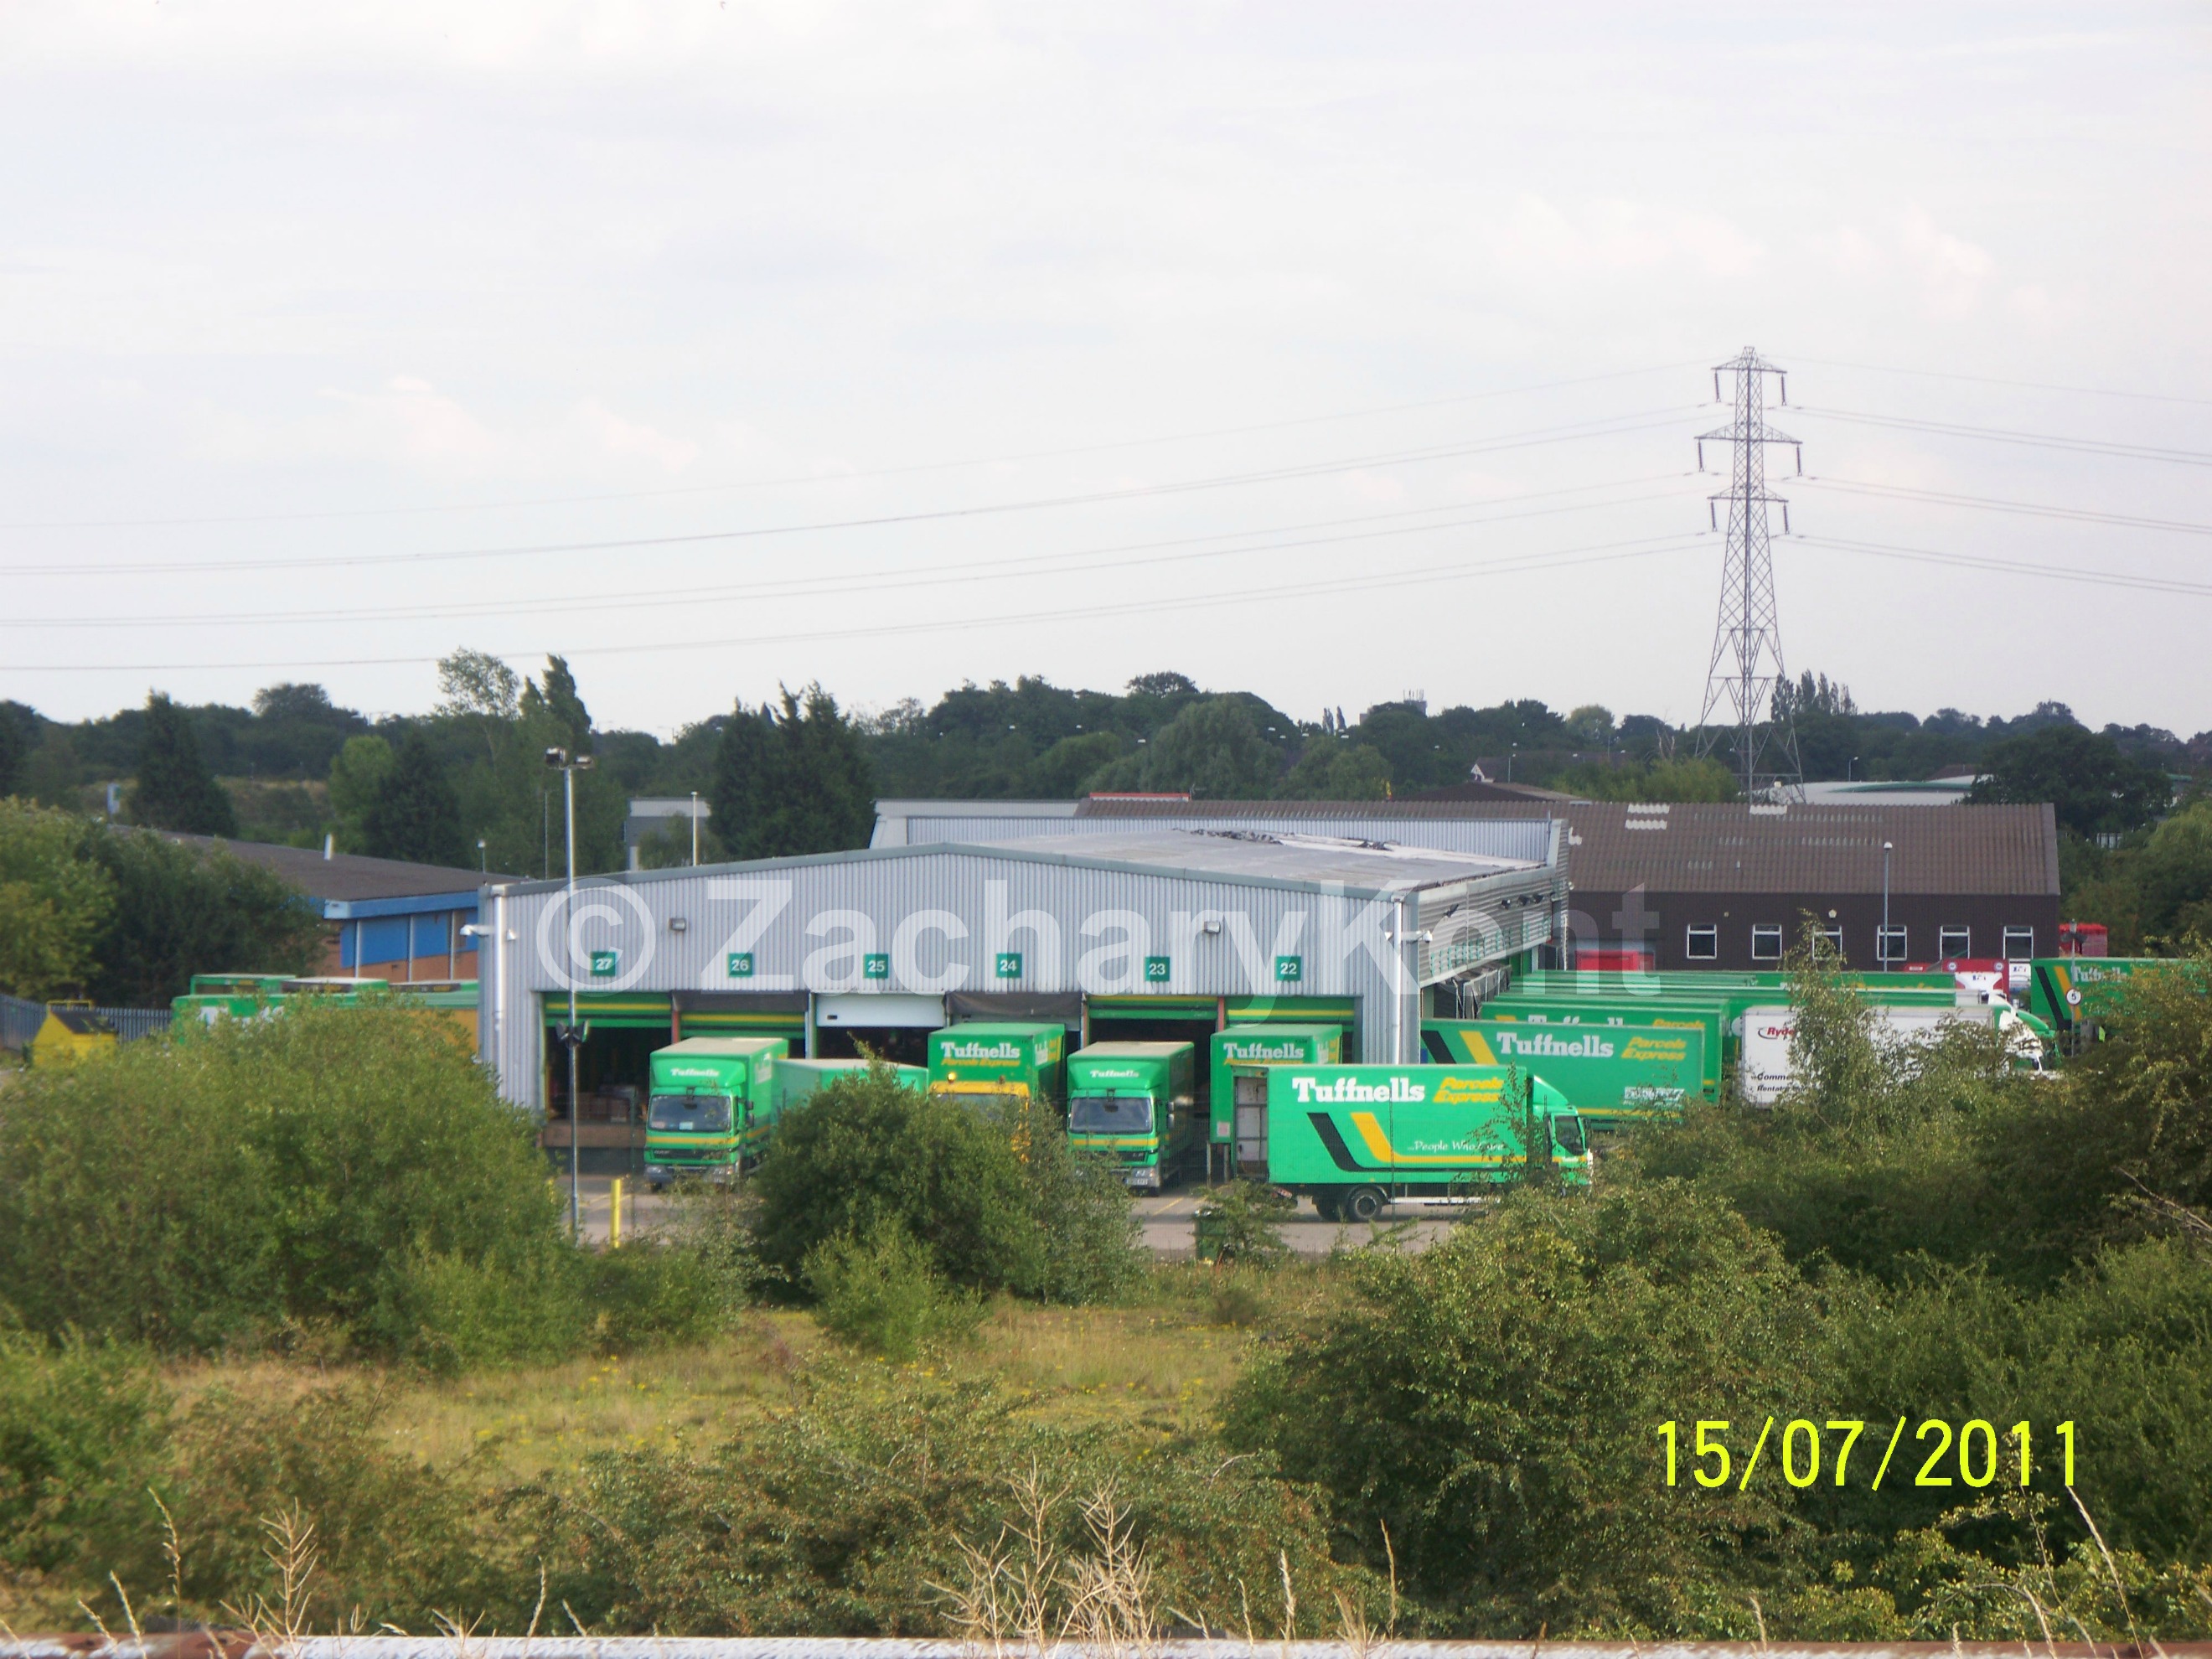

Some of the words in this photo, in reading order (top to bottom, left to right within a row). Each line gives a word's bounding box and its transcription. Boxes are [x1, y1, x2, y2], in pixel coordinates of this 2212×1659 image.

[596, 959, 612, 970] 27
[731, 959, 749, 971] 26
[867, 960, 885, 972] 25
[1000, 959, 1017, 971] 24
[1149, 964, 1165, 975] 23
[1280, 963, 1297, 974] 22
[1767, 1027, 1797, 1036] Ryde
[1496, 1031, 1615, 1057] Tuffnells
[1628, 1036, 1687, 1049] Parcels
[940, 1041, 1021, 1059] Tuffnells
[1223, 1042, 1305, 1059] Tuffnells
[1621, 1048, 1687, 1062] Express
[1440, 1077, 1505, 1089] Parcels
[1292, 1077, 1425, 1103] Tuffnells
[1433, 1090, 1501, 1104] Express
